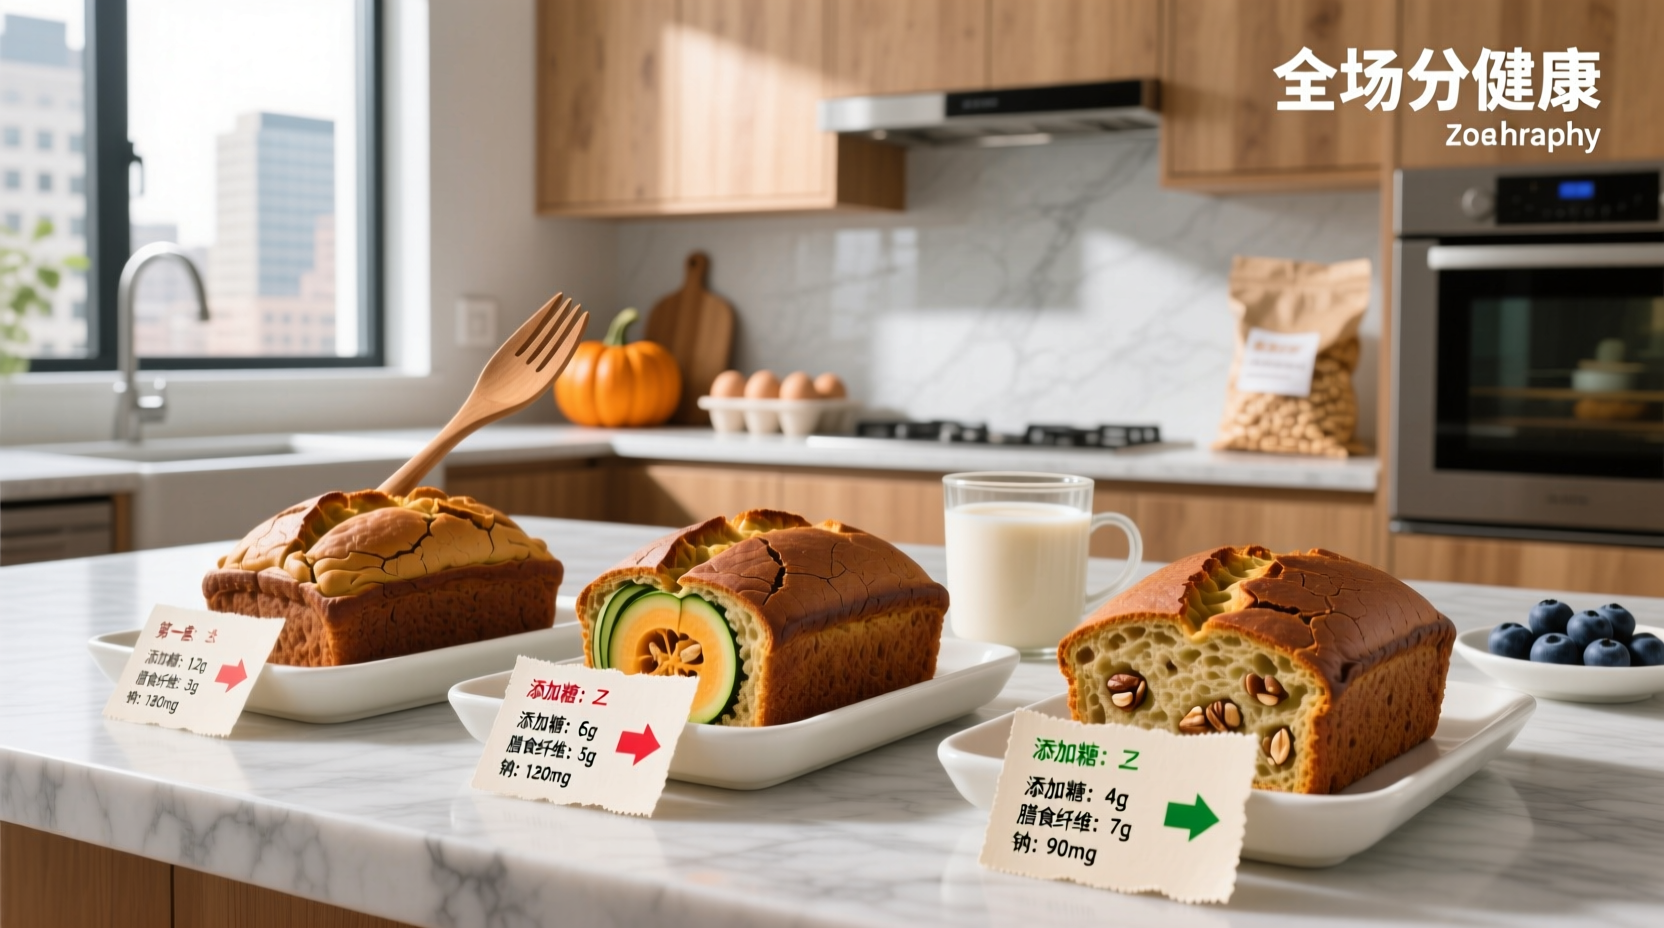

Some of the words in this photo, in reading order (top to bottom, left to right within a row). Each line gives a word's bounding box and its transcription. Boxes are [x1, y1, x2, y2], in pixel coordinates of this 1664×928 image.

[184, 679, 199, 695] 3g
[578, 721, 598, 741] 6g
[577, 747, 597, 768] 5g
[526, 764, 571, 788] 120mg
[1105, 788, 1129, 812] 4g
[1110, 818, 1132, 842] 7g
[1047, 837, 1097, 866] 90mg
